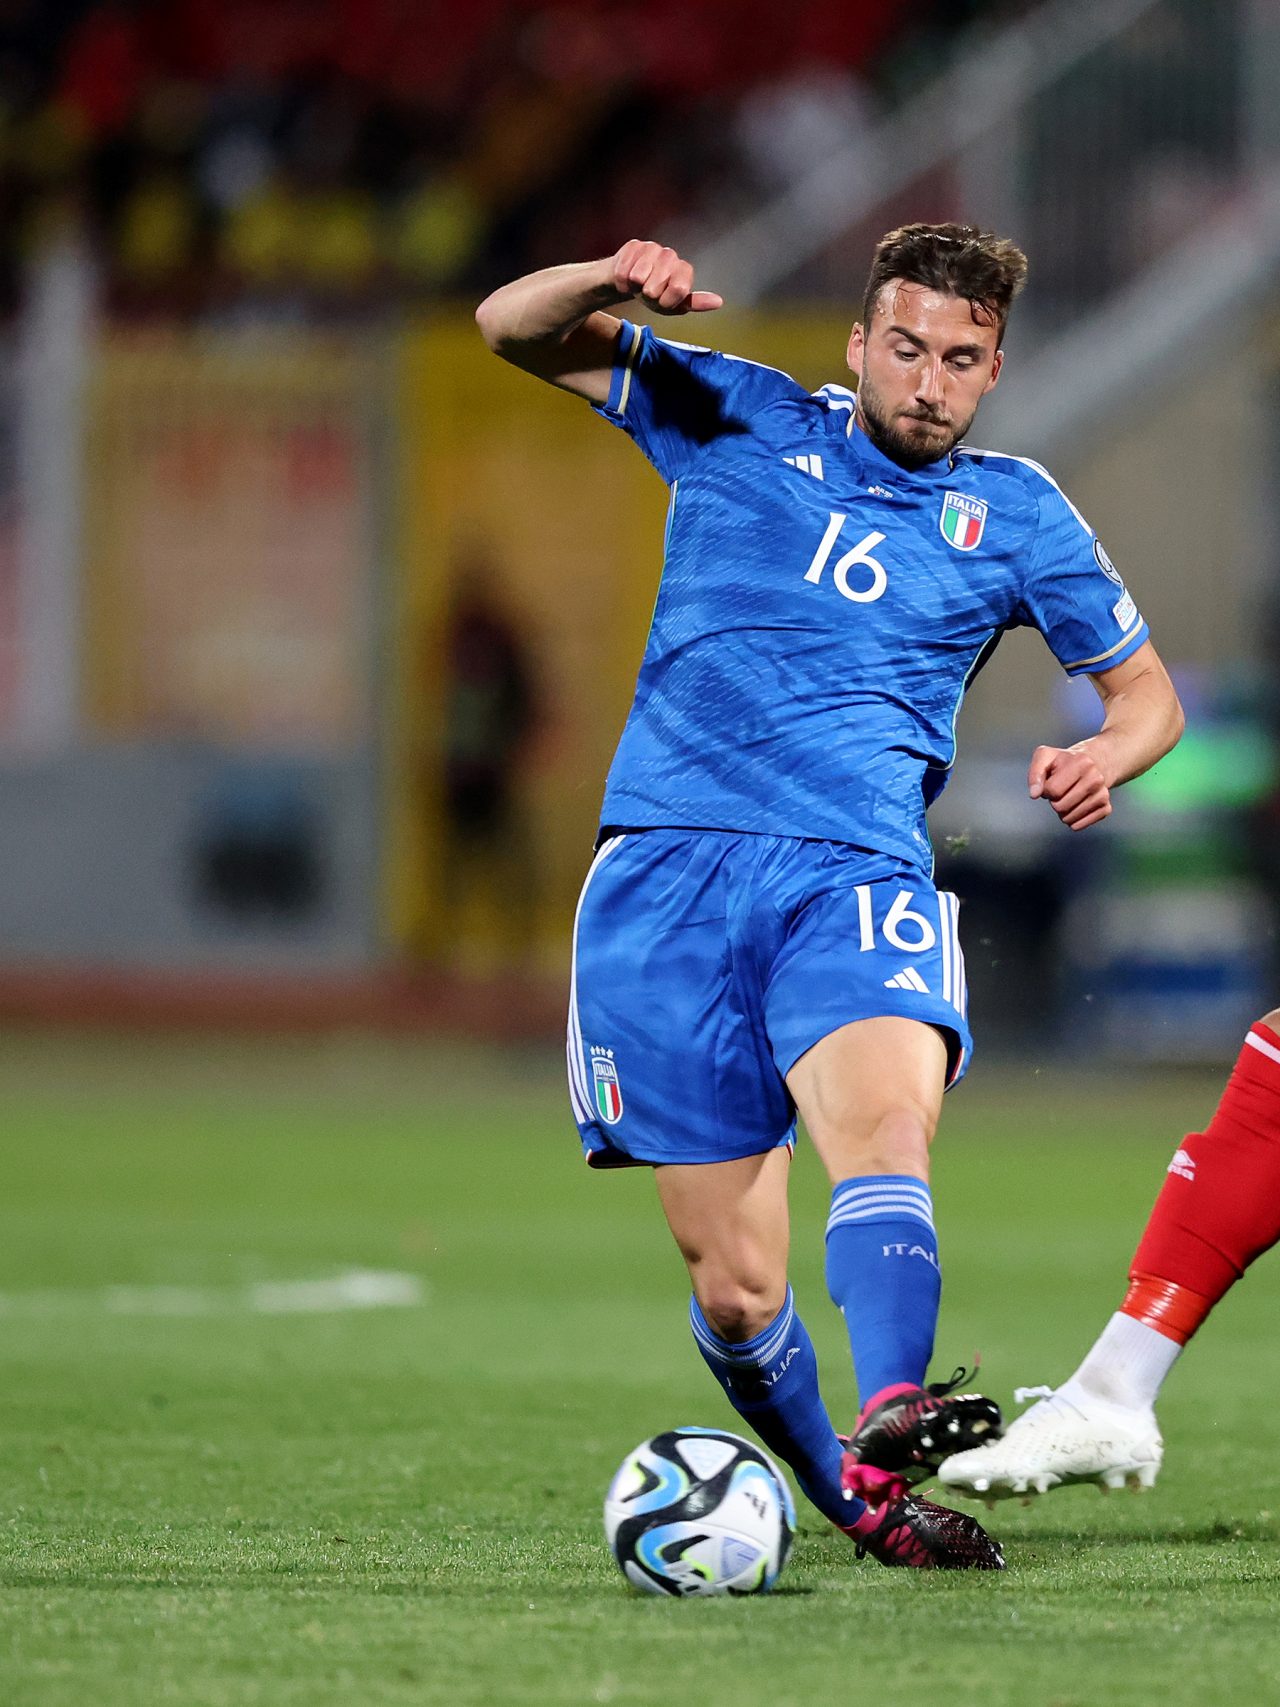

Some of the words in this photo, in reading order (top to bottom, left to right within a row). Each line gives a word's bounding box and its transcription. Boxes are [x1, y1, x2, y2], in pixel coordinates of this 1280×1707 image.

[947, 494, 984, 518] ITALIA
[803, 511, 888, 604] 16
[853, 885, 936, 953] 16
[726, 1347, 801, 1389] ILIA
